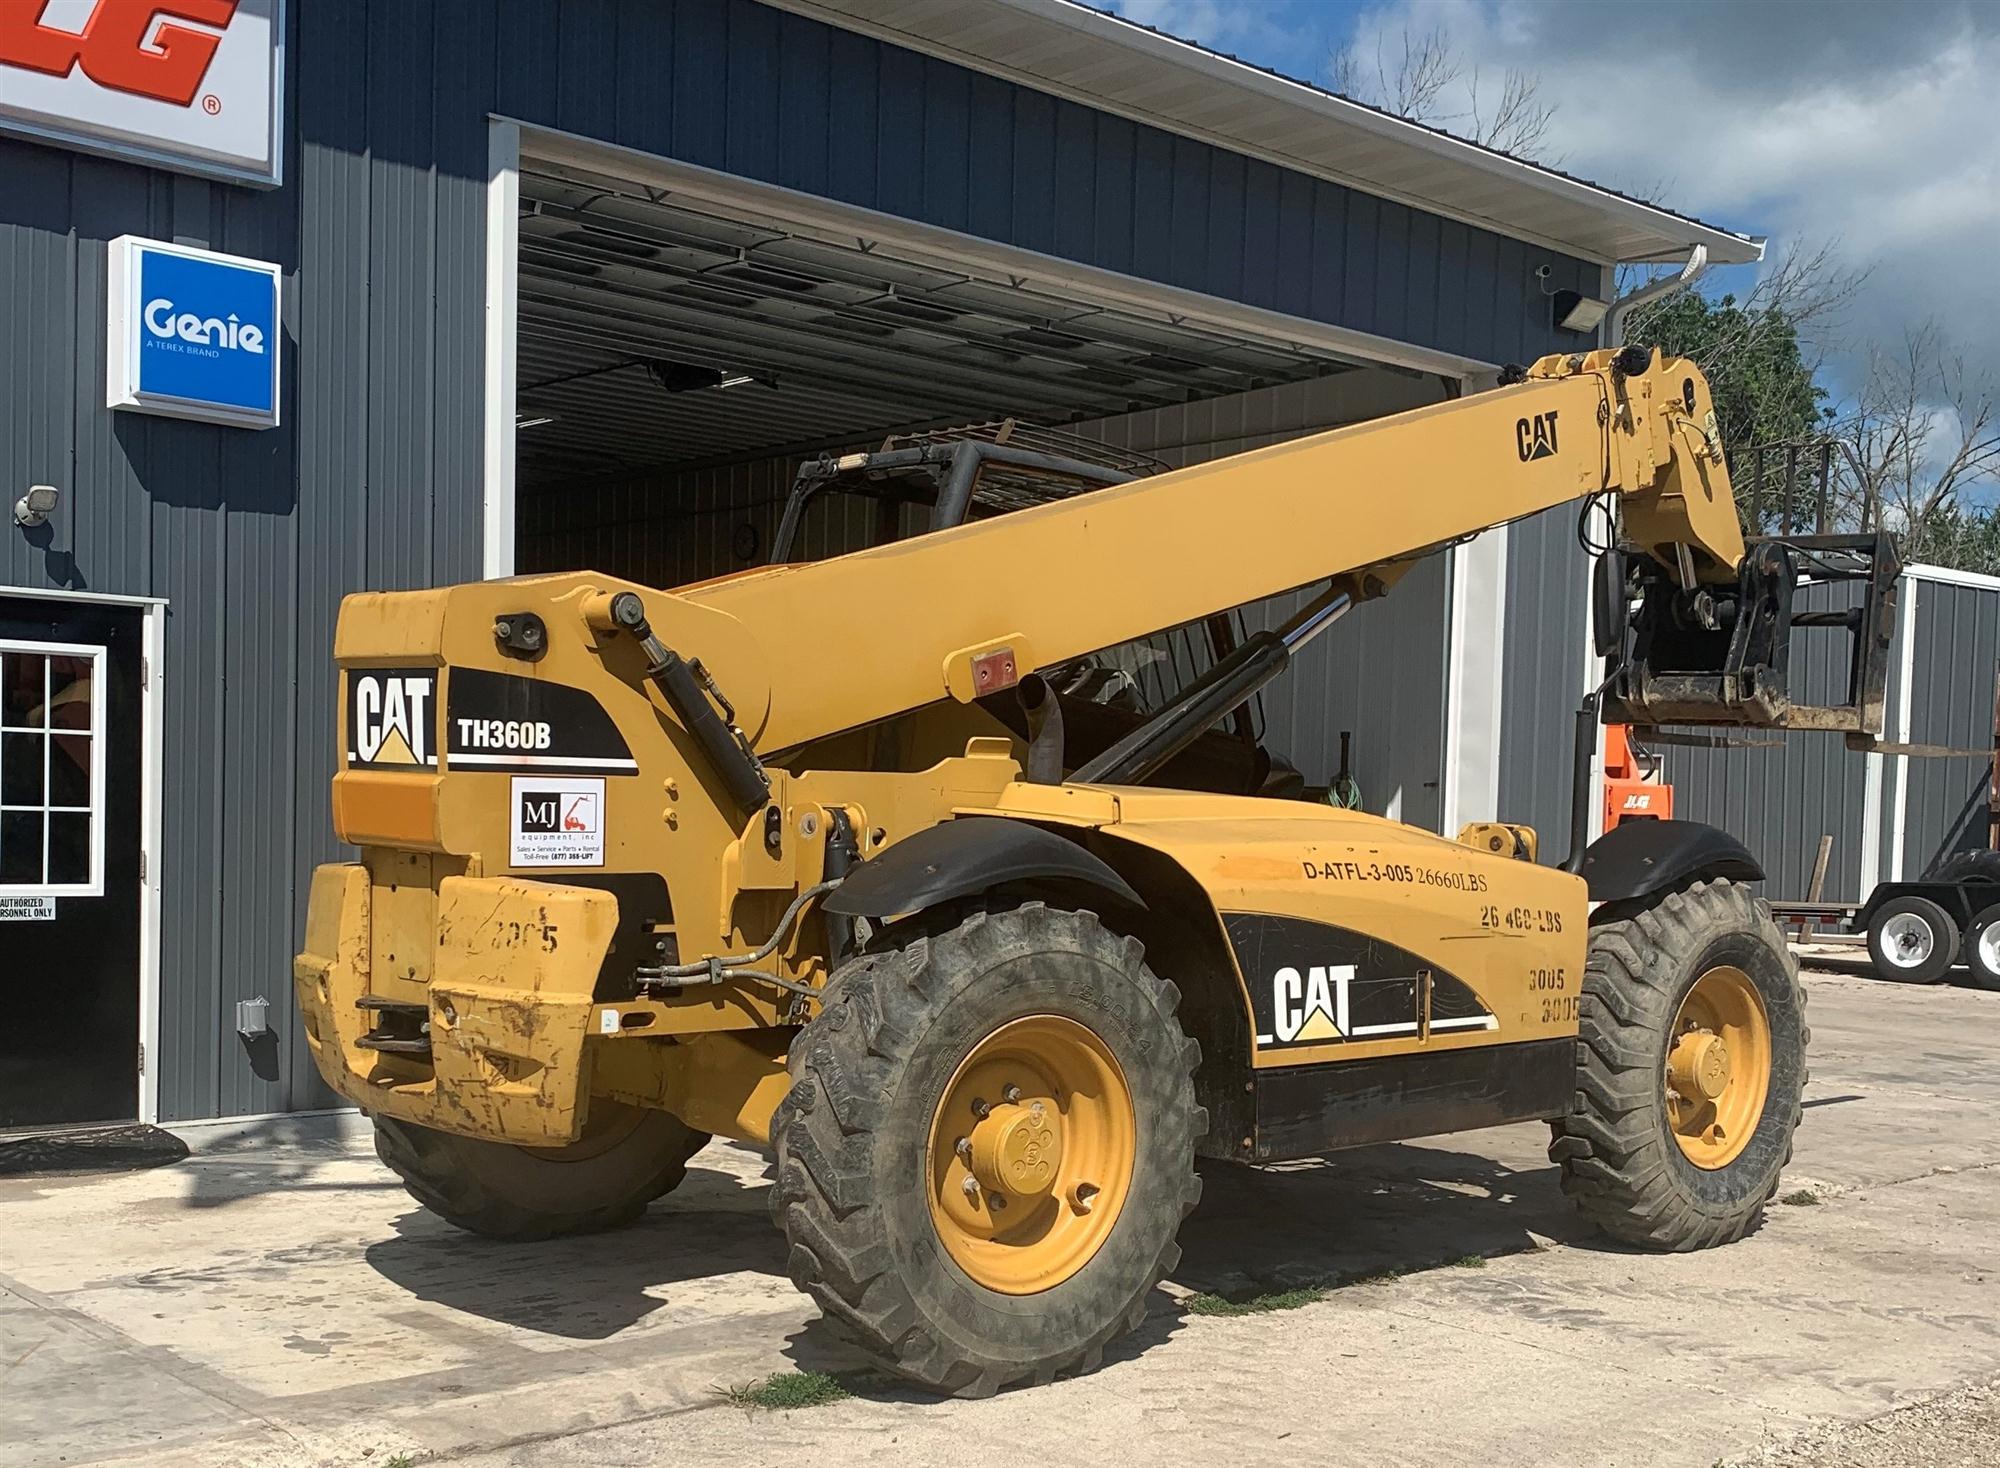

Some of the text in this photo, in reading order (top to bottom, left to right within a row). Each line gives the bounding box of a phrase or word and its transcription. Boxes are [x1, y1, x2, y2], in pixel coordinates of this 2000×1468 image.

[144, 298, 264, 354] Genie
[146, 339, 220, 359] A TEREX BRAND
[1516, 410, 1559, 463] CAT
[356, 676, 430, 764] CAT
[457, 718, 551, 750] TH360B
[524, 801, 557, 829] MJ
[1623, 795, 1651, 809] JLG
[551, 853, 567, 861] (877)
[1302, 861, 1489, 893] D-ATFL-3-005 26660LBS
[0, 898, 44, 907] AUTHORIZED
[33, 908, 52, 918] ONLY
[1273, 965, 1355, 1042] CAT
